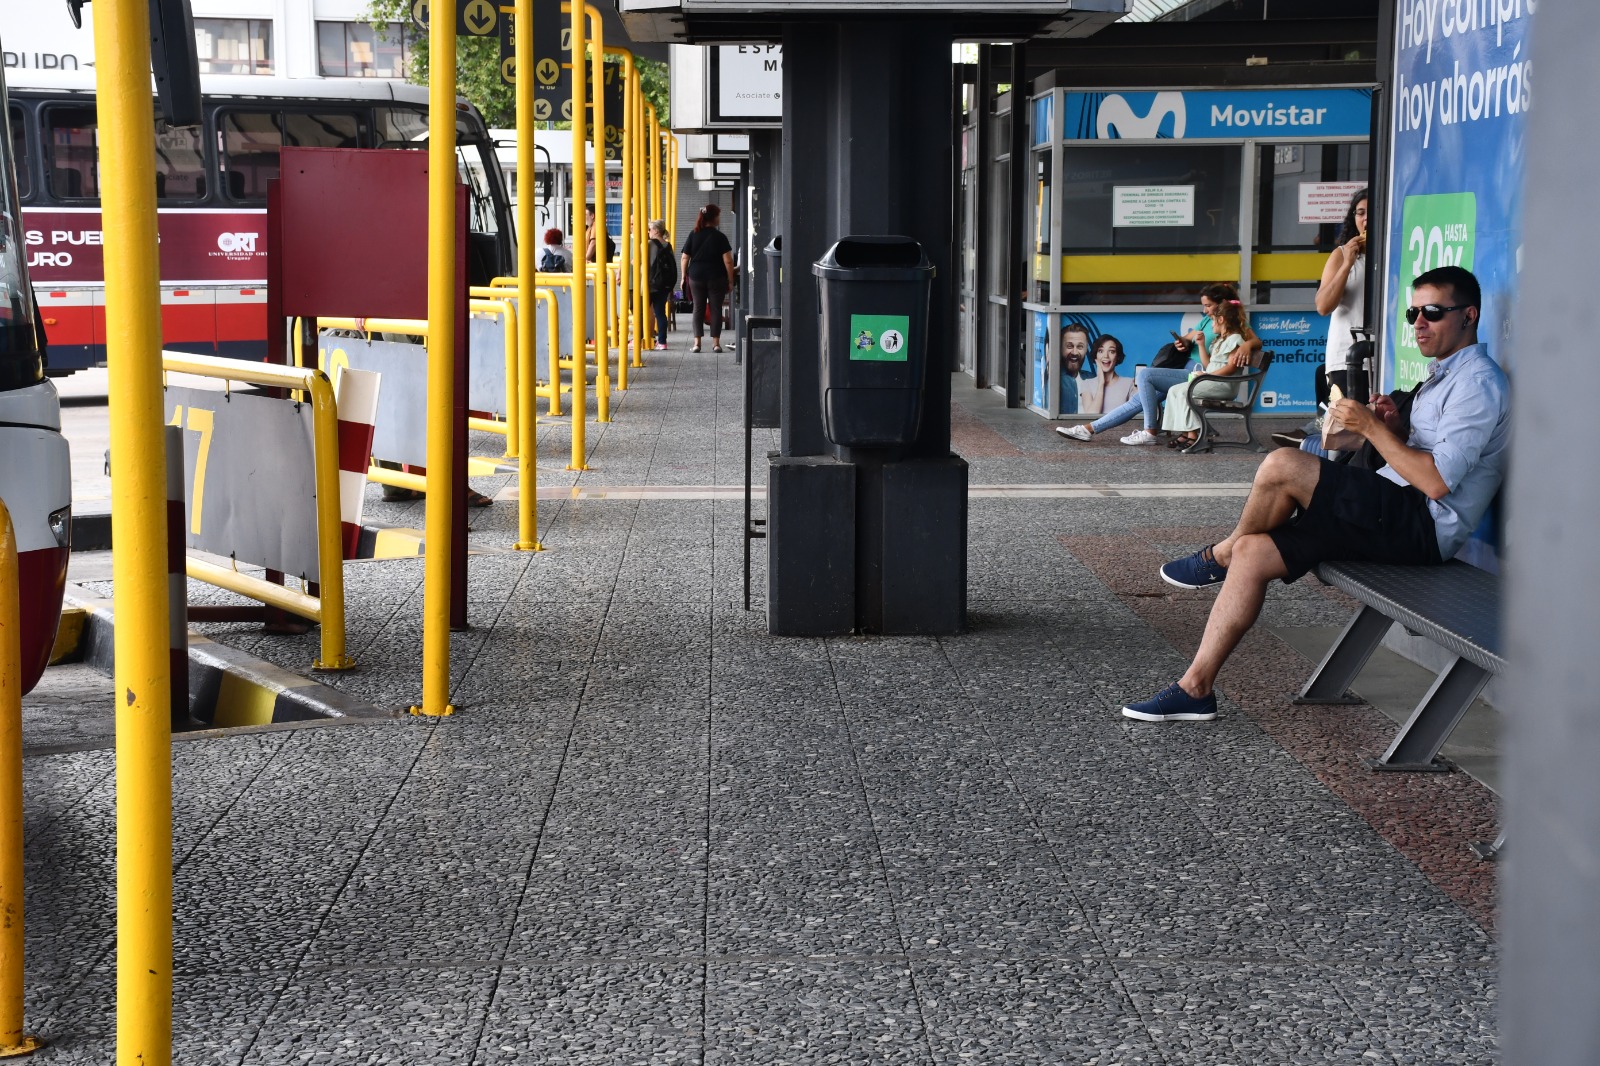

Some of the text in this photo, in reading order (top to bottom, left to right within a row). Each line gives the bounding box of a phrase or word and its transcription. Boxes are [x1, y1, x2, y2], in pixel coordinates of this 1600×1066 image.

[1401, 0, 1438, 64] Hoy
[1399, 40, 1534, 149] hoy ahorrás
[1210, 103, 1327, 127] Movistar
[217, 232, 259, 252] ORT
[1444, 224, 1468, 242] HASTA
[1261, 339, 1305, 347] enemos
[1400, 359, 1409, 379] EN
